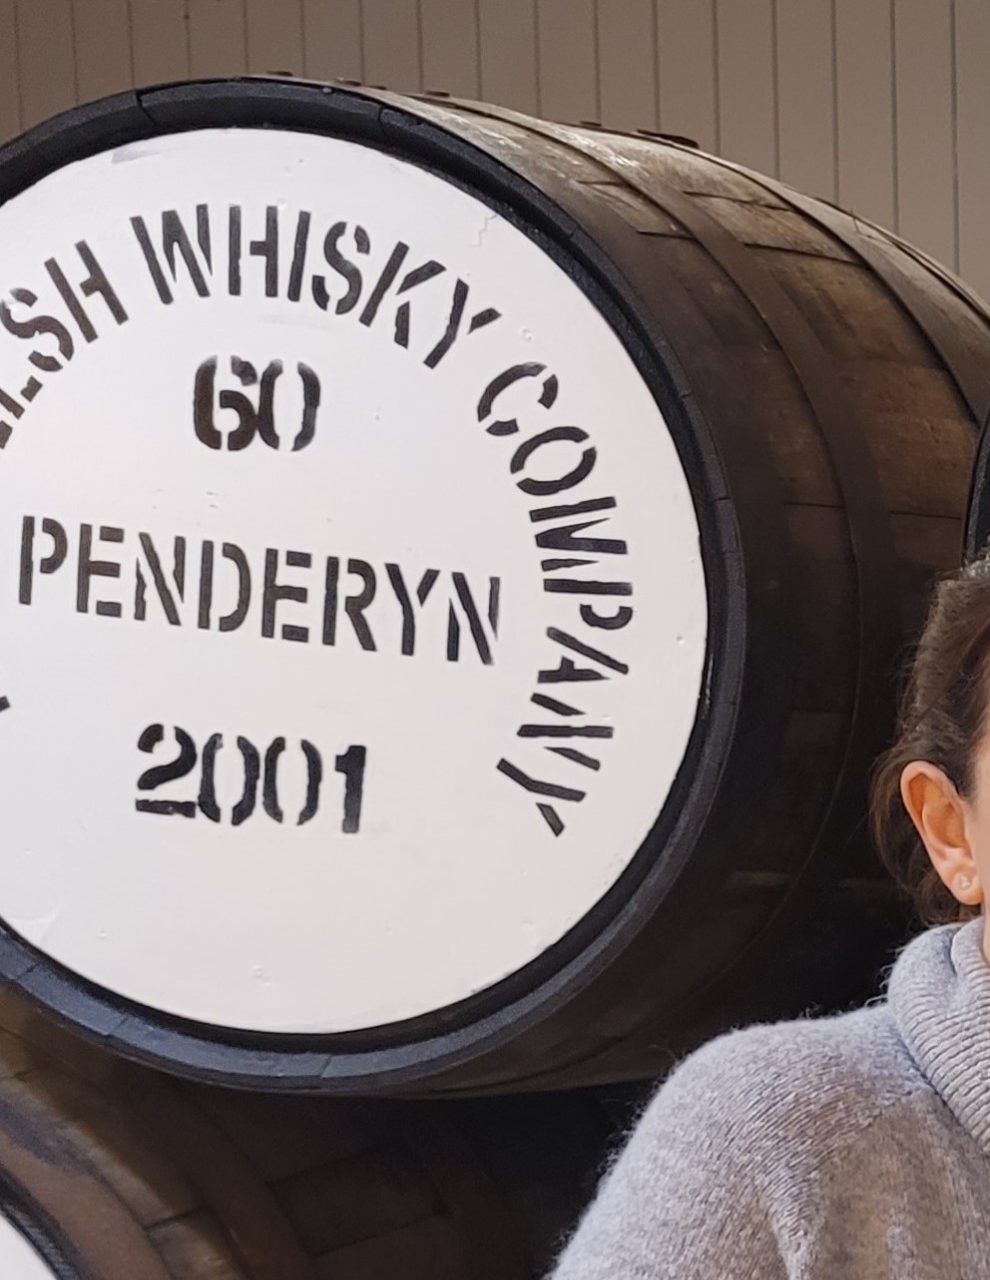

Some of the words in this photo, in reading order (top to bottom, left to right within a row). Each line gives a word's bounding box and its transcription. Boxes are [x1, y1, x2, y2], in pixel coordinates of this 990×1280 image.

[193, 354, 321, 452] 60
[130, 204, 501, 369] WHISKY
[477, 362, 634, 836] COMPANY
[18, 514, 500, 666] PENDERYN
[135, 723, 367, 834] 2001
